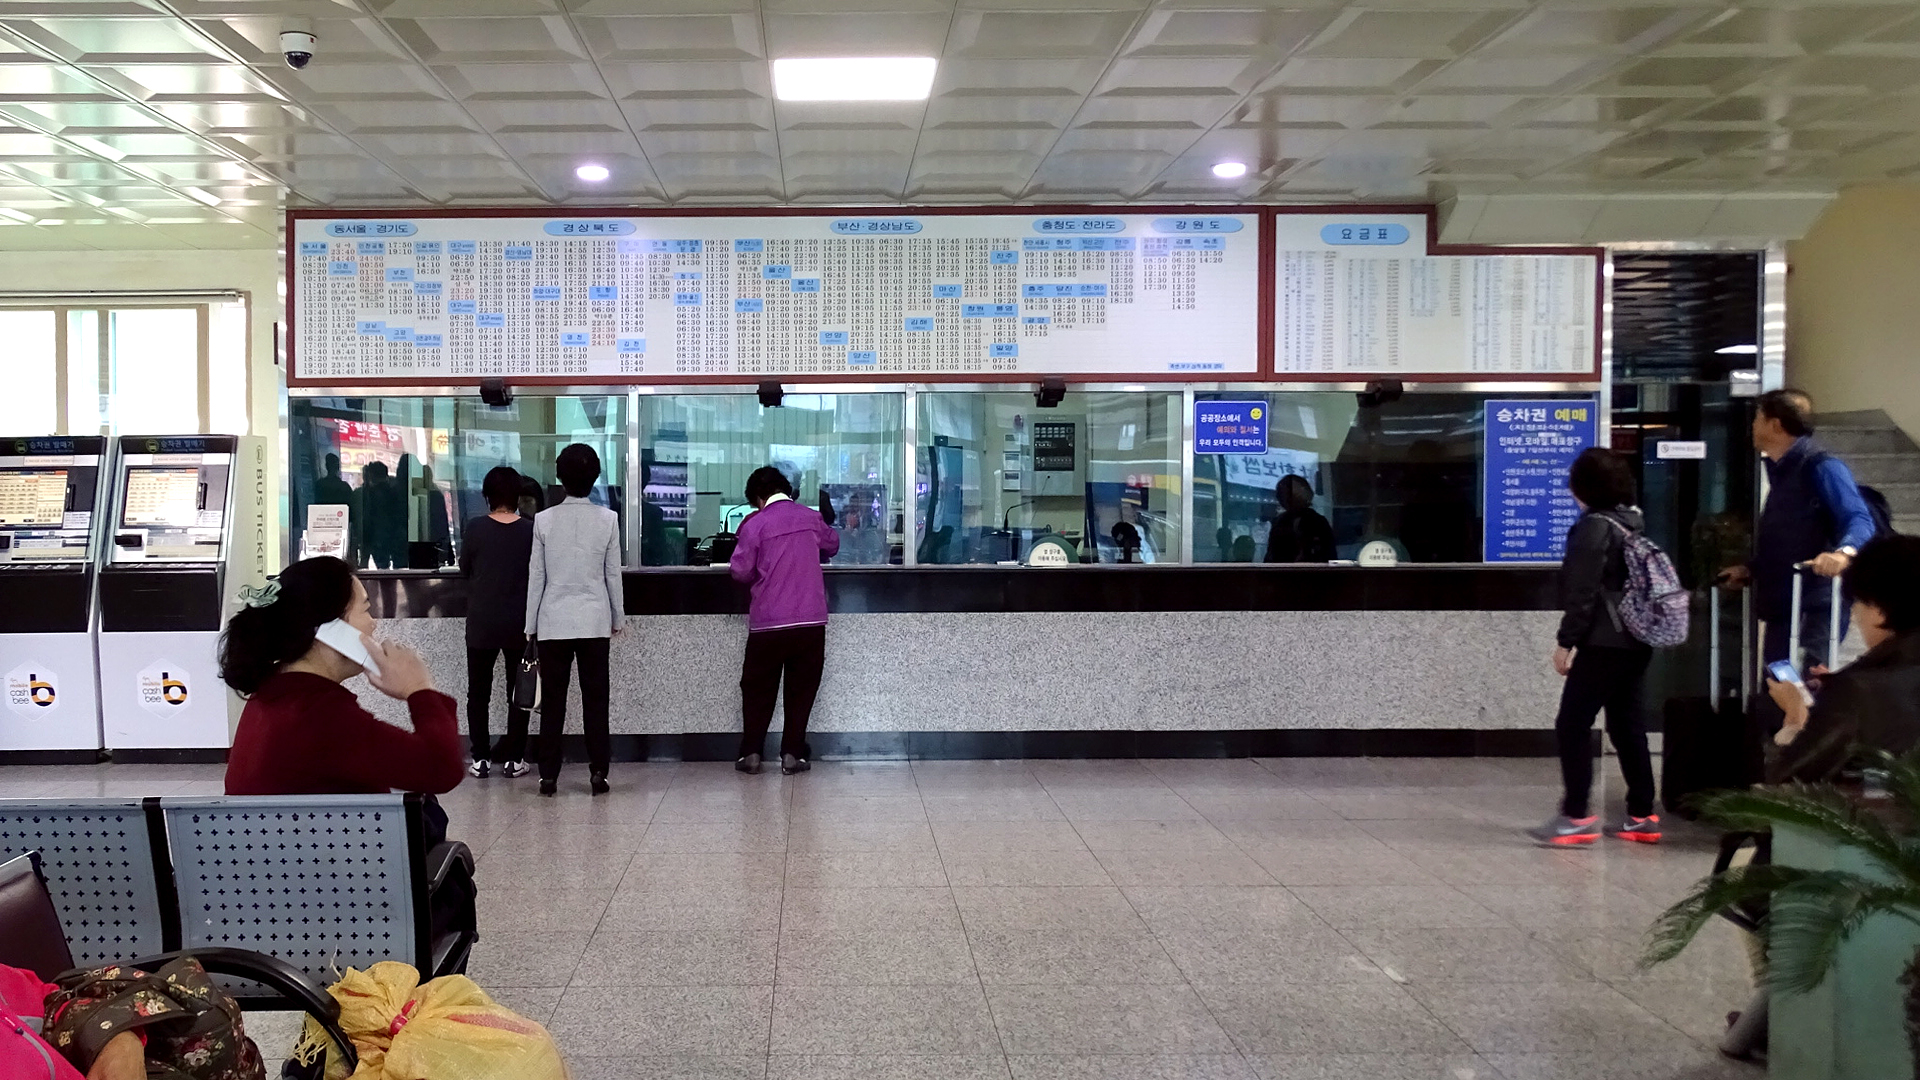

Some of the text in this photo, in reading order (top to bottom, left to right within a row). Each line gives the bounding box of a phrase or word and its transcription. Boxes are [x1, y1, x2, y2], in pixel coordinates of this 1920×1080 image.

[563, 224, 619, 232] 경상북도
[1175, 220, 1220, 230] 강원도
[1341, 228, 1388, 240] 요금표
[1200, 414, 1241, 423] 공공장소에서
[1496, 408, 1588, 423] 승차권 예매
[1199, 438, 1211, 447] 우리
[1213, 438, 1231, 447] 모두의
[10, 689, 29, 697] cash
[142, 687, 161, 695] cash
[145, 694, 161, 703] bee
